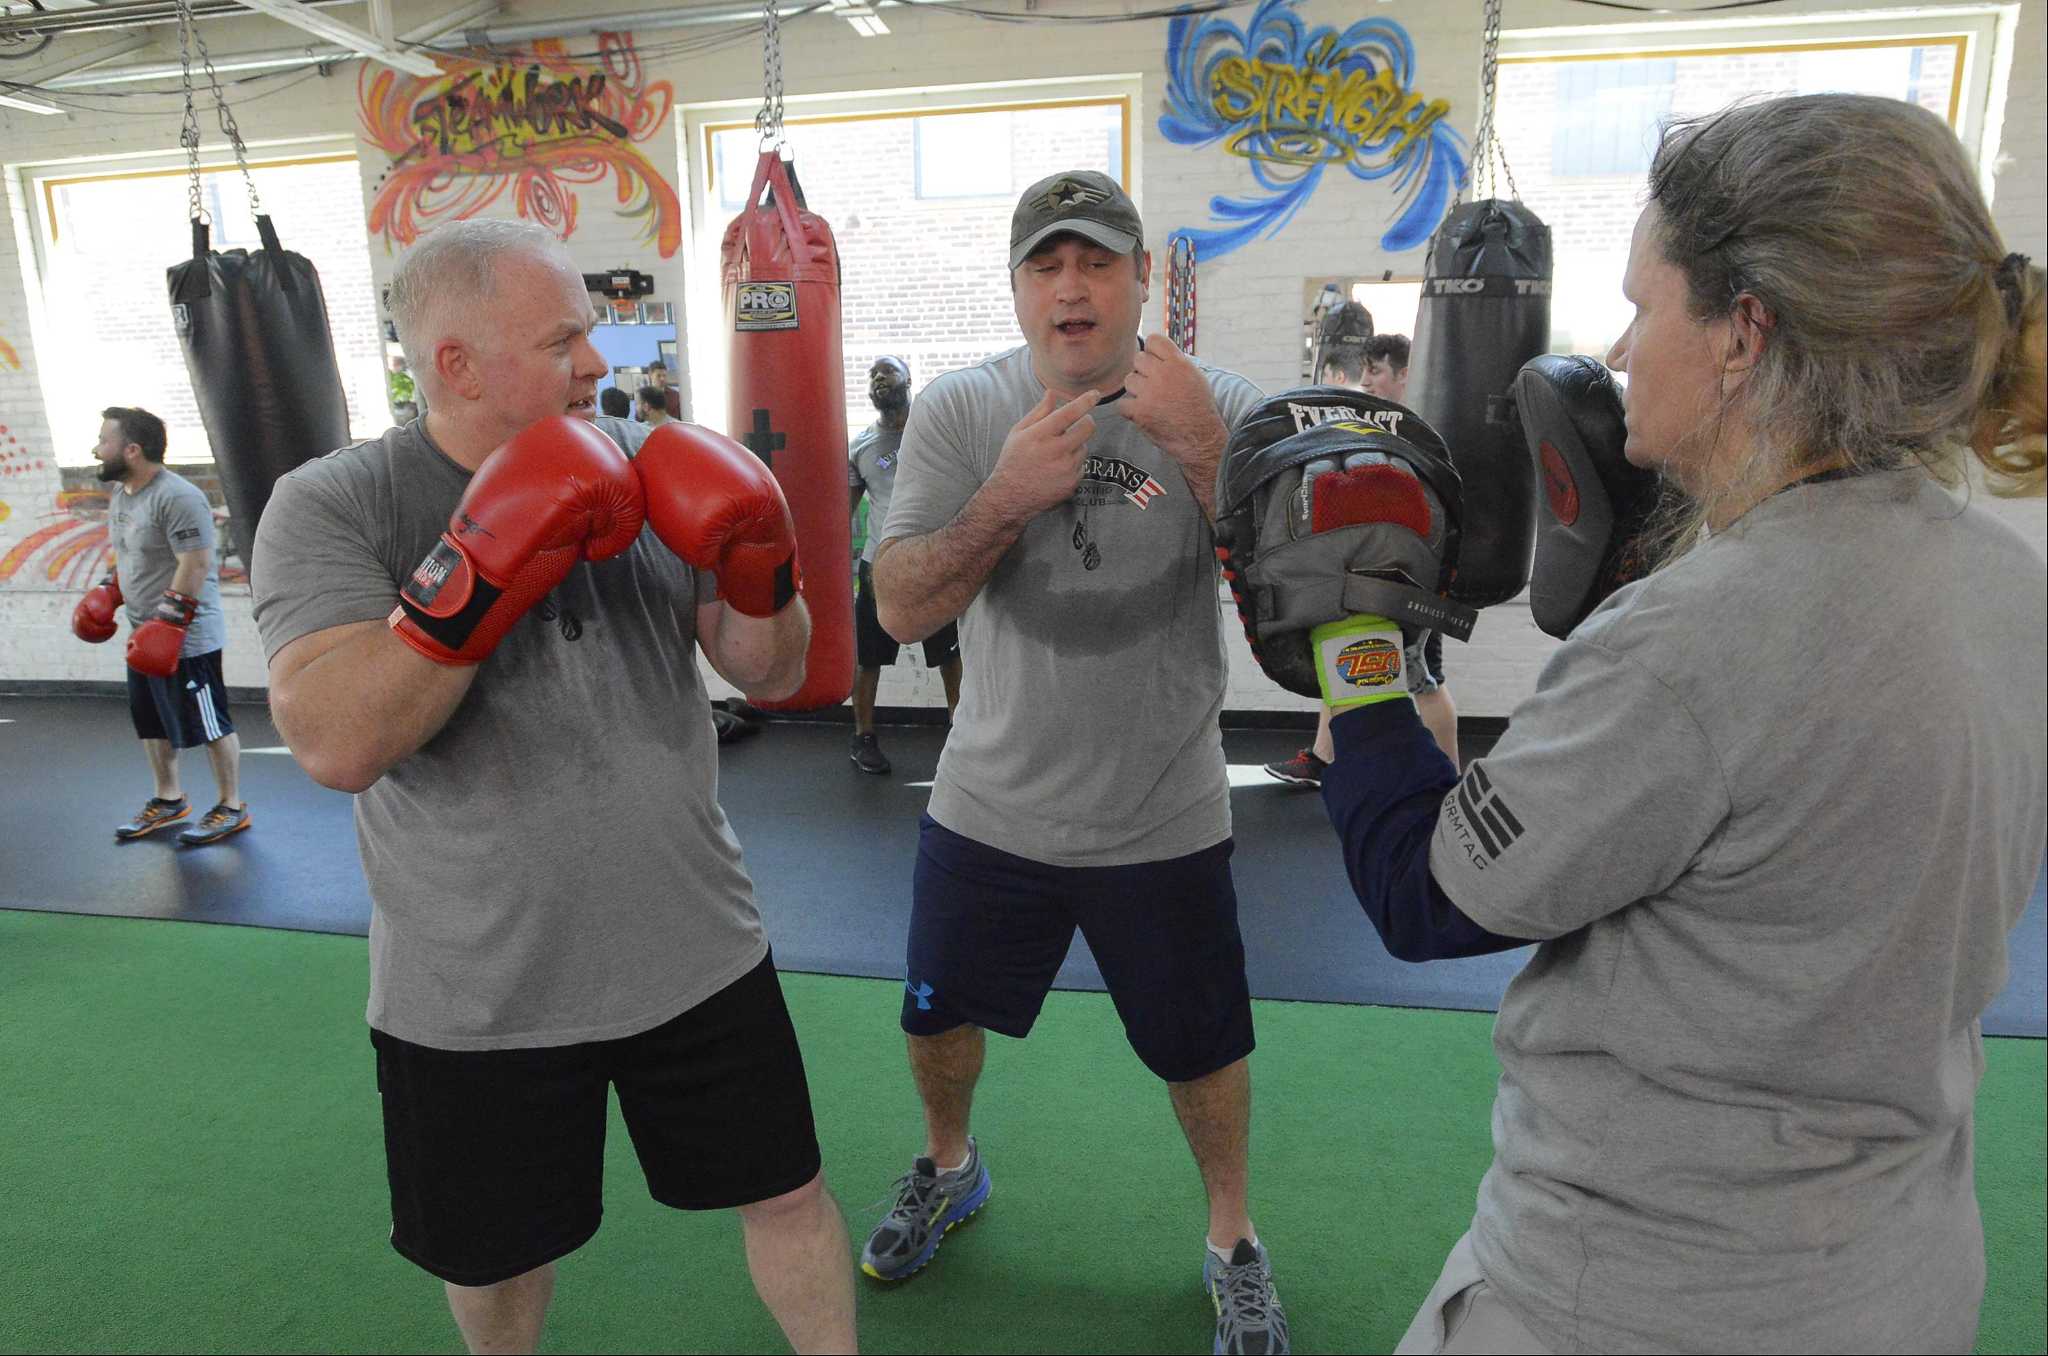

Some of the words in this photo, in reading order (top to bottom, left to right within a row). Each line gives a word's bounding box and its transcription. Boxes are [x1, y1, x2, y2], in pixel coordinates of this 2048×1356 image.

[1433, 278, 1485, 294] TKO
[1514, 280, 1551, 295] TK
[740, 291, 790, 309] PRO
[1081, 458, 1143, 488] ERANS
